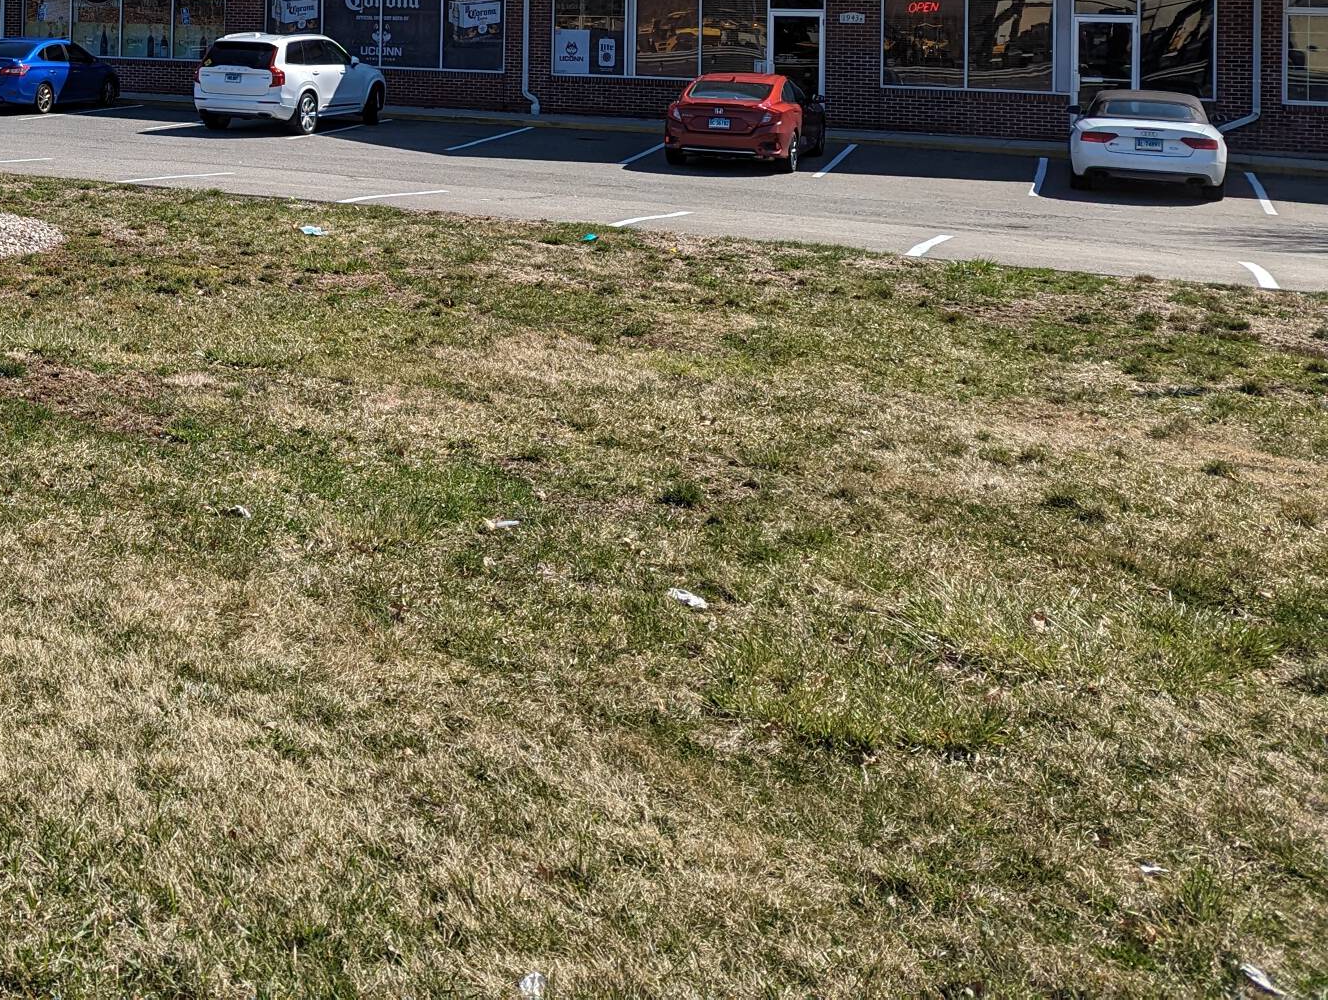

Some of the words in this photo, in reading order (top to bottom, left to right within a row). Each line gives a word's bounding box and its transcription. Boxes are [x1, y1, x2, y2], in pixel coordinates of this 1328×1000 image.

[908, 1, 940, 13] OPEN
[468, 8, 497, 20] Corona
[360, 45, 403, 57] UCONN
[559, 55, 584, 63] UCONN
